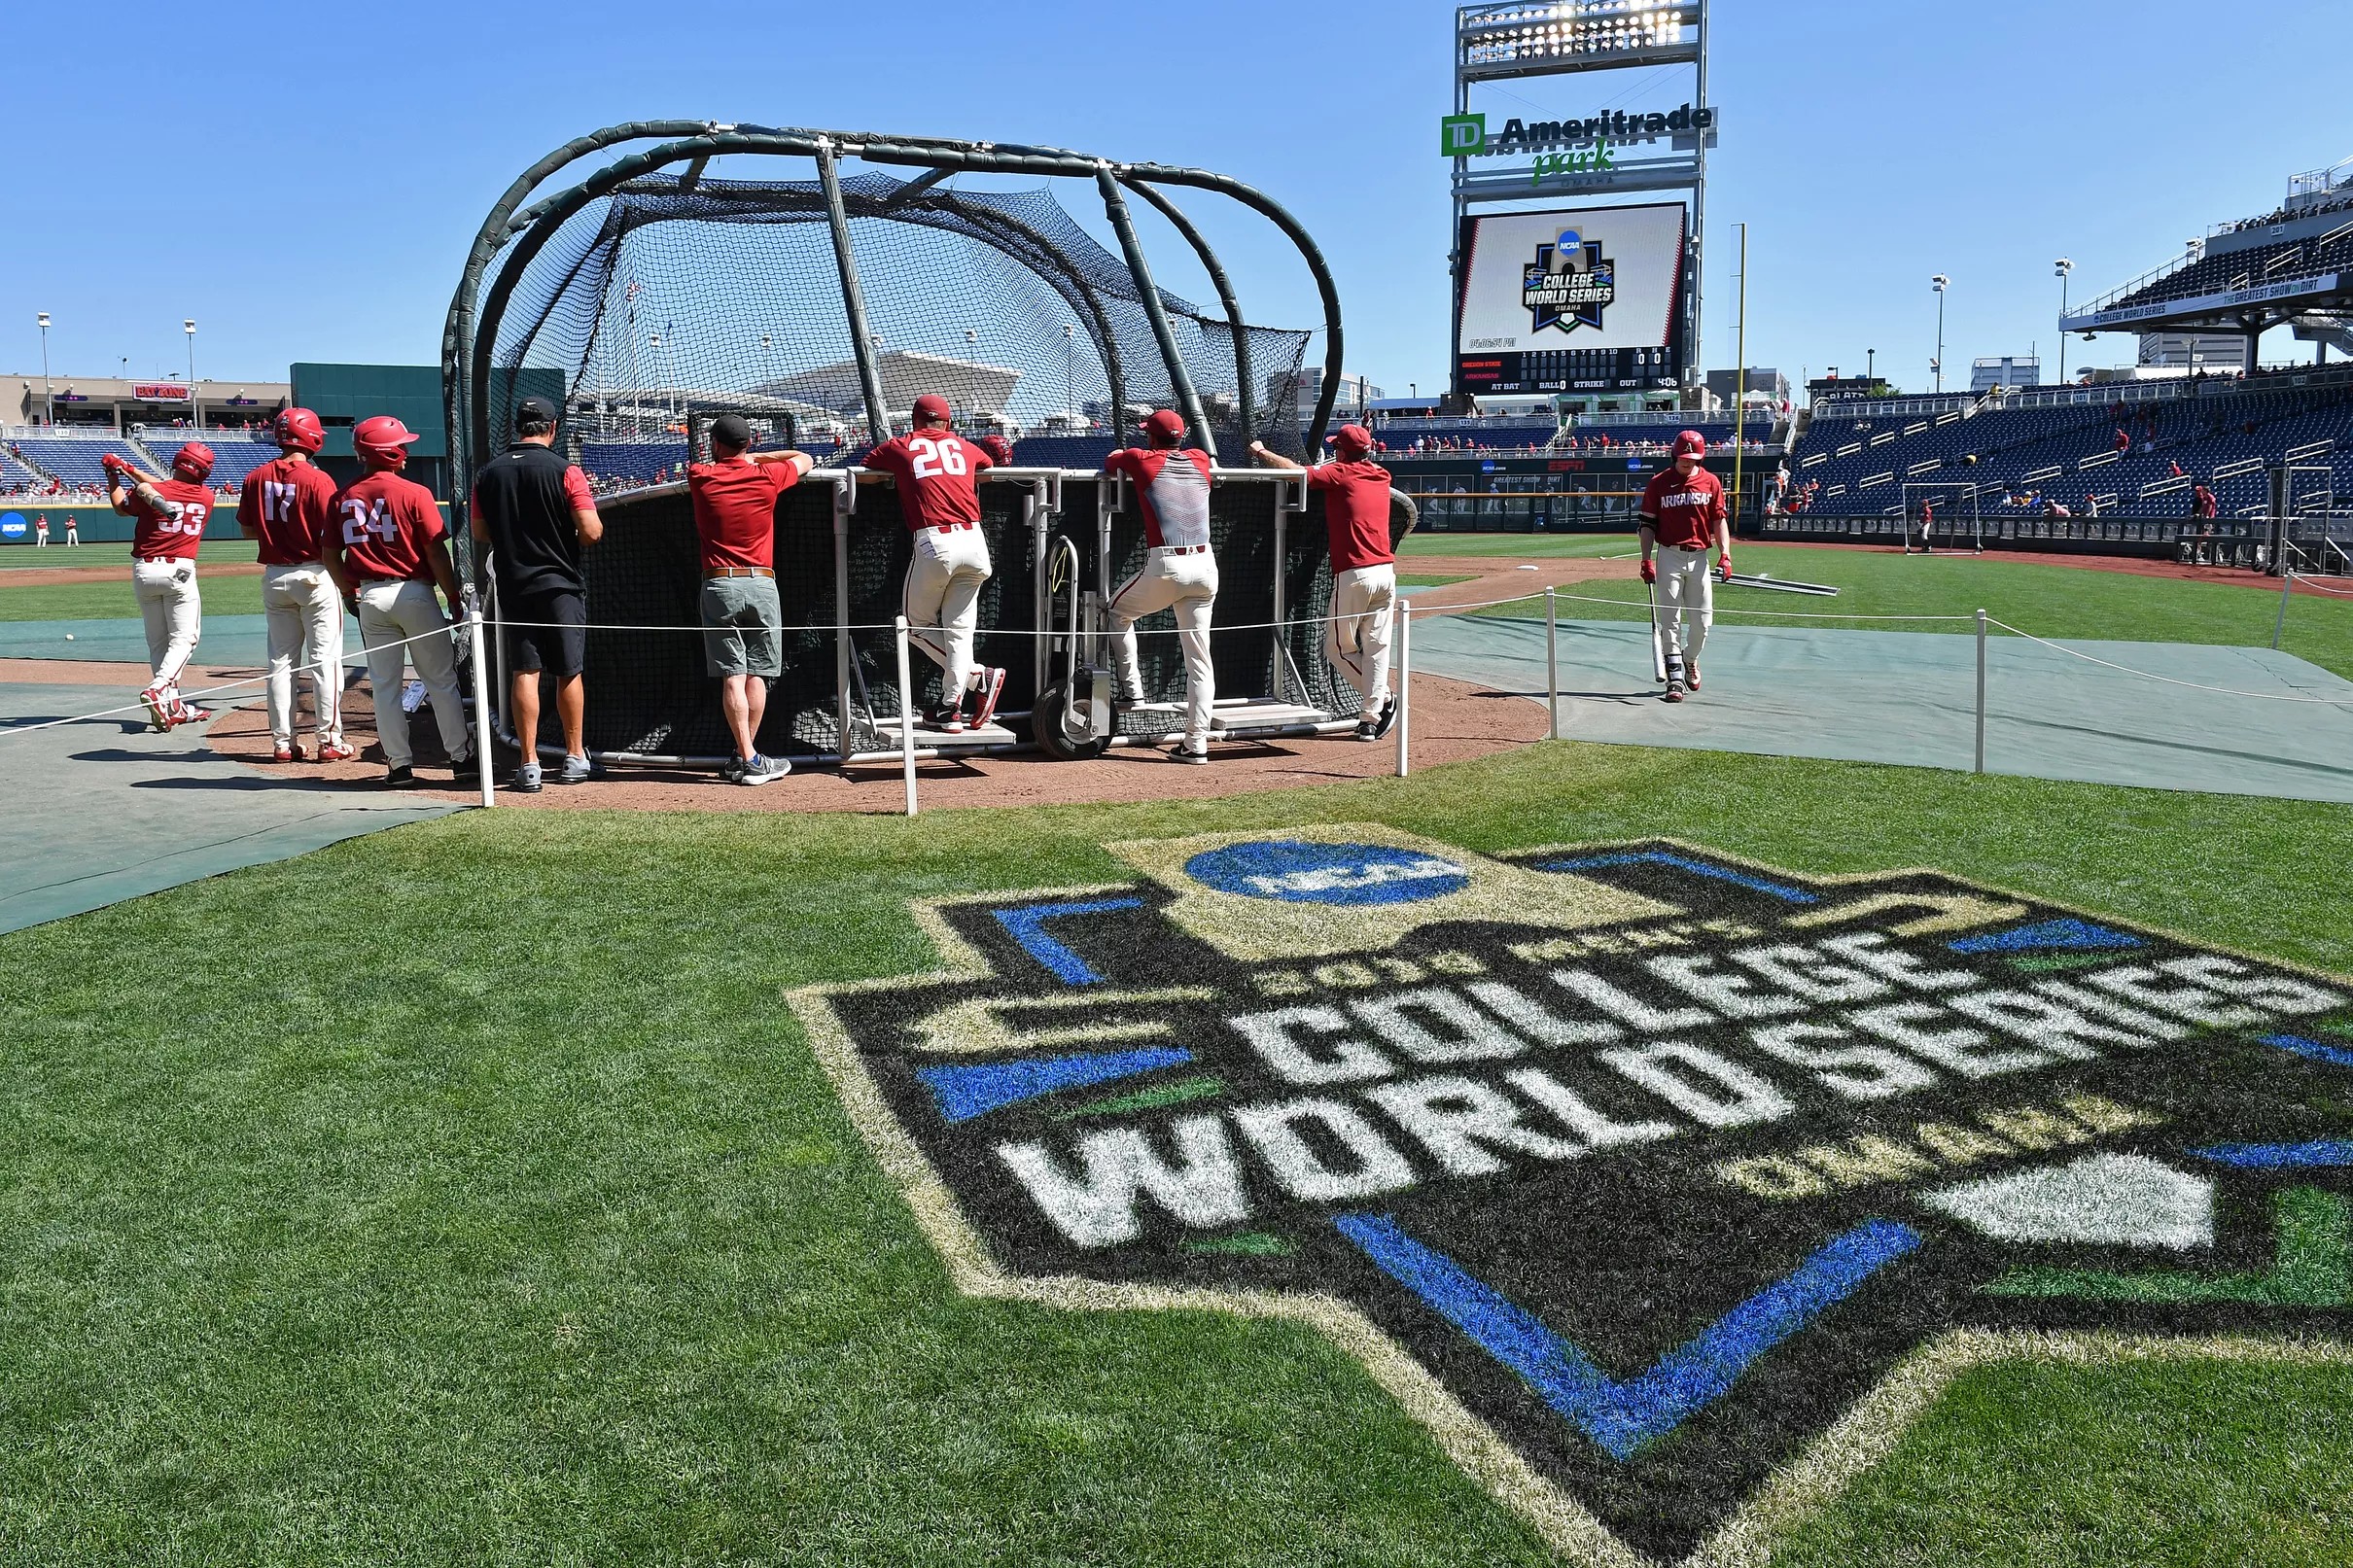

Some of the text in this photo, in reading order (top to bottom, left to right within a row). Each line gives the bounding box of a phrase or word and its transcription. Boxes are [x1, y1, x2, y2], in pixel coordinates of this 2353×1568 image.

[1446, 102, 1712, 148] TD Ameritrade
[1531, 136, 1615, 187] park
[1561, 176, 1615, 188] OMAHA
[2271, 226, 2283, 234] 201
[1542, 273, 1595, 290] COLLEGE
[1525, 287, 1612, 305] WORLD SERIES
[2234, 288, 2269, 303] GREATEST
[2269, 283, 2292, 297] SHOW
[2300, 279, 2318, 293] DIRT
[2099, 304, 2166, 323] COLLEGE WORLD SERIES
[1503, 337, 1516, 347] PM
[1637, 353, 1645, 365] 0
[1654, 352, 1662, 365] 0
[1560, 380, 1566, 390] 0
[1657, 377, 1678, 387] 4:06
[158, 388, 187, 399] ZONE
[1683, 442, 1694, 453] A
[908, 437, 966, 479] 26
[1548, 461, 1585, 471] ESPN
[264, 481, 297, 523] 17
[1661, 492, 1712, 508] ARKANSAS
[341, 499, 398, 544] 24
[1228, 930, 1984, 1086] COLLEGE
[994, 953, 2348, 1250] WORLD SERIES
[1719, 1094, 2163, 1202] OMAHA
